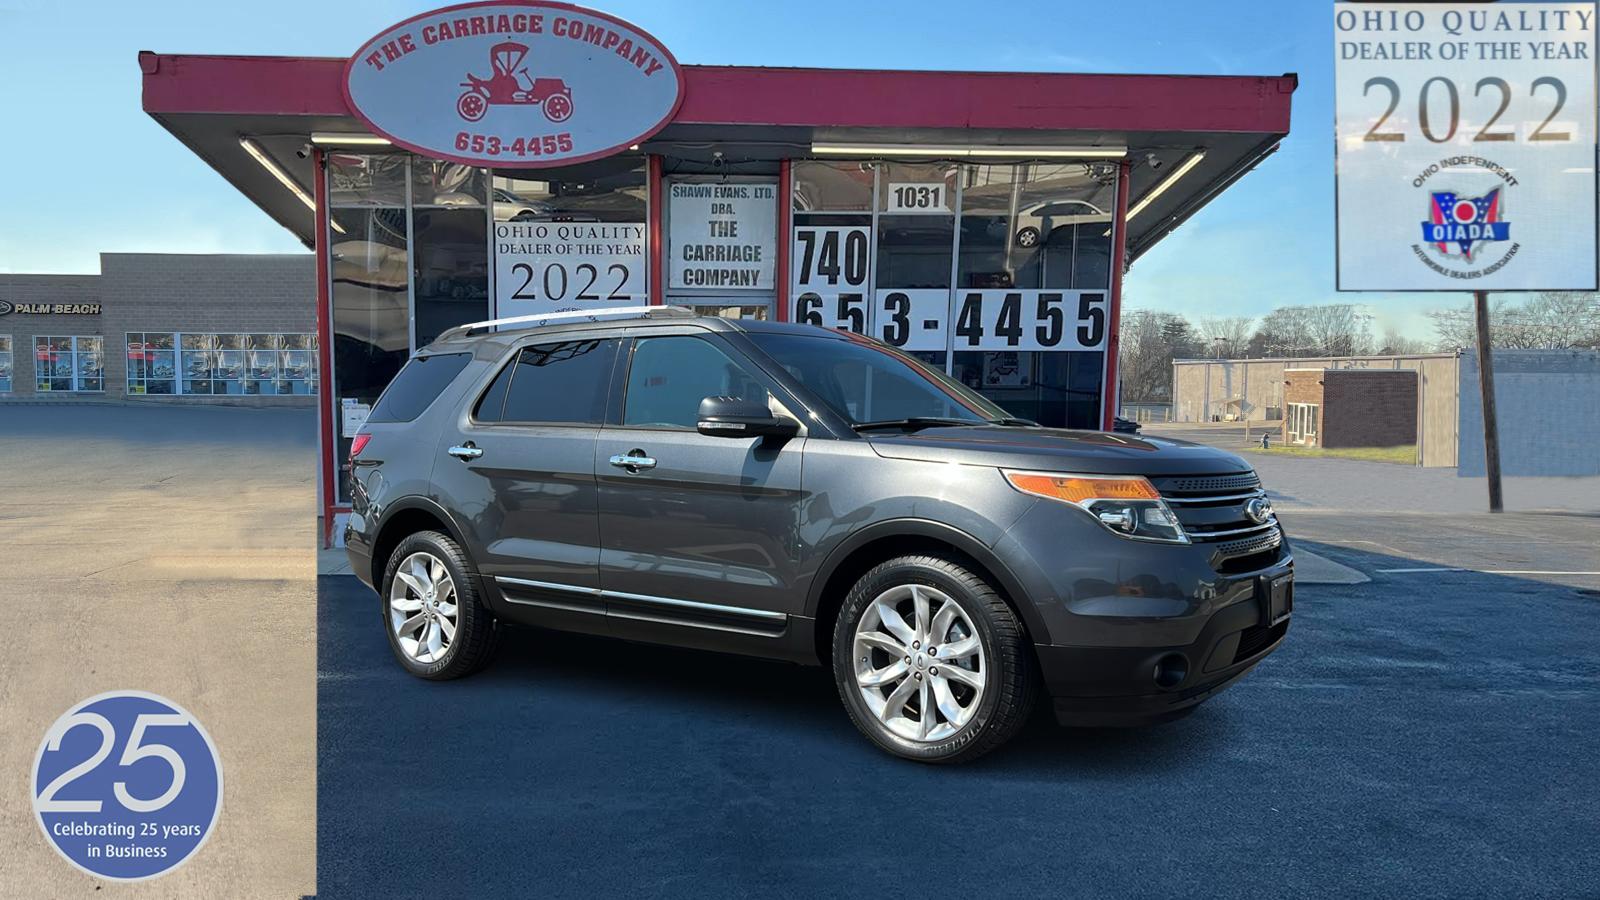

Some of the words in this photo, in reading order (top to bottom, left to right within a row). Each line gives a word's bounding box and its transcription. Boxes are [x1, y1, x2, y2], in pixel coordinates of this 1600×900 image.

[1336, 10, 1425, 32] OHIO
[1442, 10, 1593, 35] QUALITY
[366, 34, 416, 71] THE
[422, 14, 544, 46] CARRIAGE
[552, 17, 664, 77] COMPANY
[1340, 42, 1433, 60] DEALER
[1438, 42, 1469, 60] OF
[1475, 42, 1522, 60] THE
[1528, 42, 1589, 60] YEAR
[1362, 76, 1571, 144] 2022
[455, 132, 573, 156] 653-4455
[1412, 163, 1439, 188] OHIO
[1440, 155, 1519, 187] INDEPENDENT
[672, 186, 713, 199] SHAWN
[714, 186, 751, 199] EVANS.
[754, 187, 775, 199] LTD.
[894, 186, 940, 208] 1031
[711, 203, 736, 215] DBA.
[497, 226, 549, 239] OHIO
[558, 226, 643, 241] QUALITY
[708, 221, 738, 237] THE
[1432, 224, 1495, 240] OIADA
[499, 243, 552, 255] DEALER
[555, 243, 574, 255] OF
[576, 243, 603, 255] THE
[606, 243, 641, 255] YEAR
[683, 244, 762, 262] CARRIAGE
[797, 230, 868, 286] 740
[511, 262, 632, 301] 2022
[683, 268, 760, 286] COMPANY
[1450, 270, 1482, 280] DEALERS
[14, 304, 51, 314] PALM
[54, 304, 100, 314] BEACH
